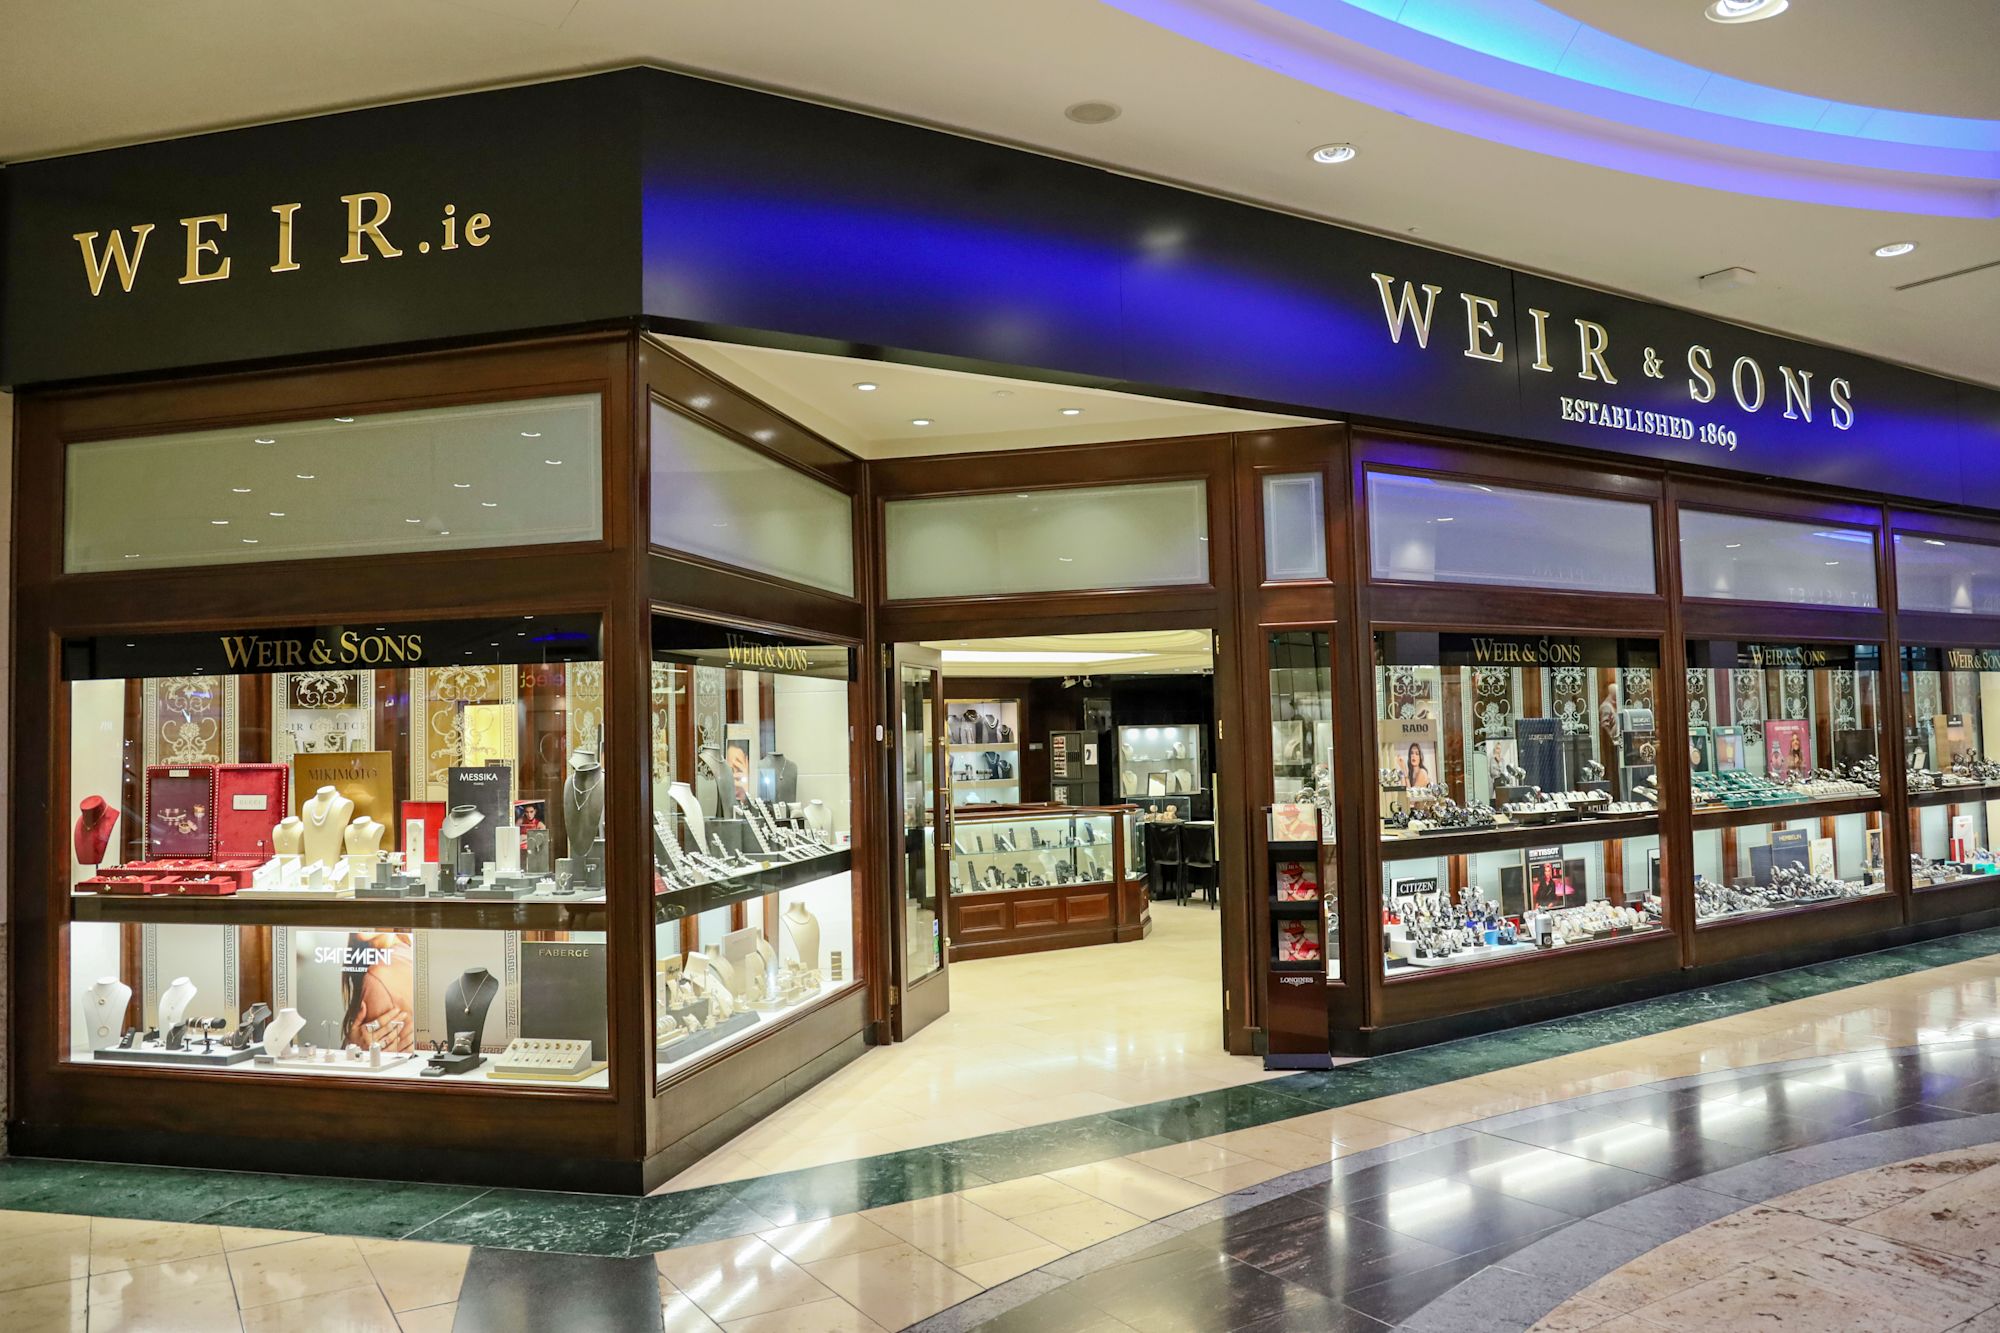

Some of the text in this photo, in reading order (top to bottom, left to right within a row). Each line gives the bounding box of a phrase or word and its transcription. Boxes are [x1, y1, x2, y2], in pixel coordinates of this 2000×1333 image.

[1371, 272, 1854, 431] WEIR & SONS
[1560, 396, 1738, 452] ESTABLISHED 1869
[220, 631, 422, 669] WEIR & SONS
[725, 632, 807, 671] WEIR & SONS
[1471, 637, 1581, 663] WEIR & SONS
[1749, 644, 1826, 667] WEIR & SONS
[1948, 650, 2000, 669] WEIR & SON
[1402, 723, 1429, 733] RADO
[459, 772, 499, 782] MESSIKA
[1538, 847, 1560, 856] TISSOT
[1400, 880, 1434, 894] CITIZEN
[314, 946, 395, 966] STATEMENT
[538, 948, 590, 958] FABERGÉ
